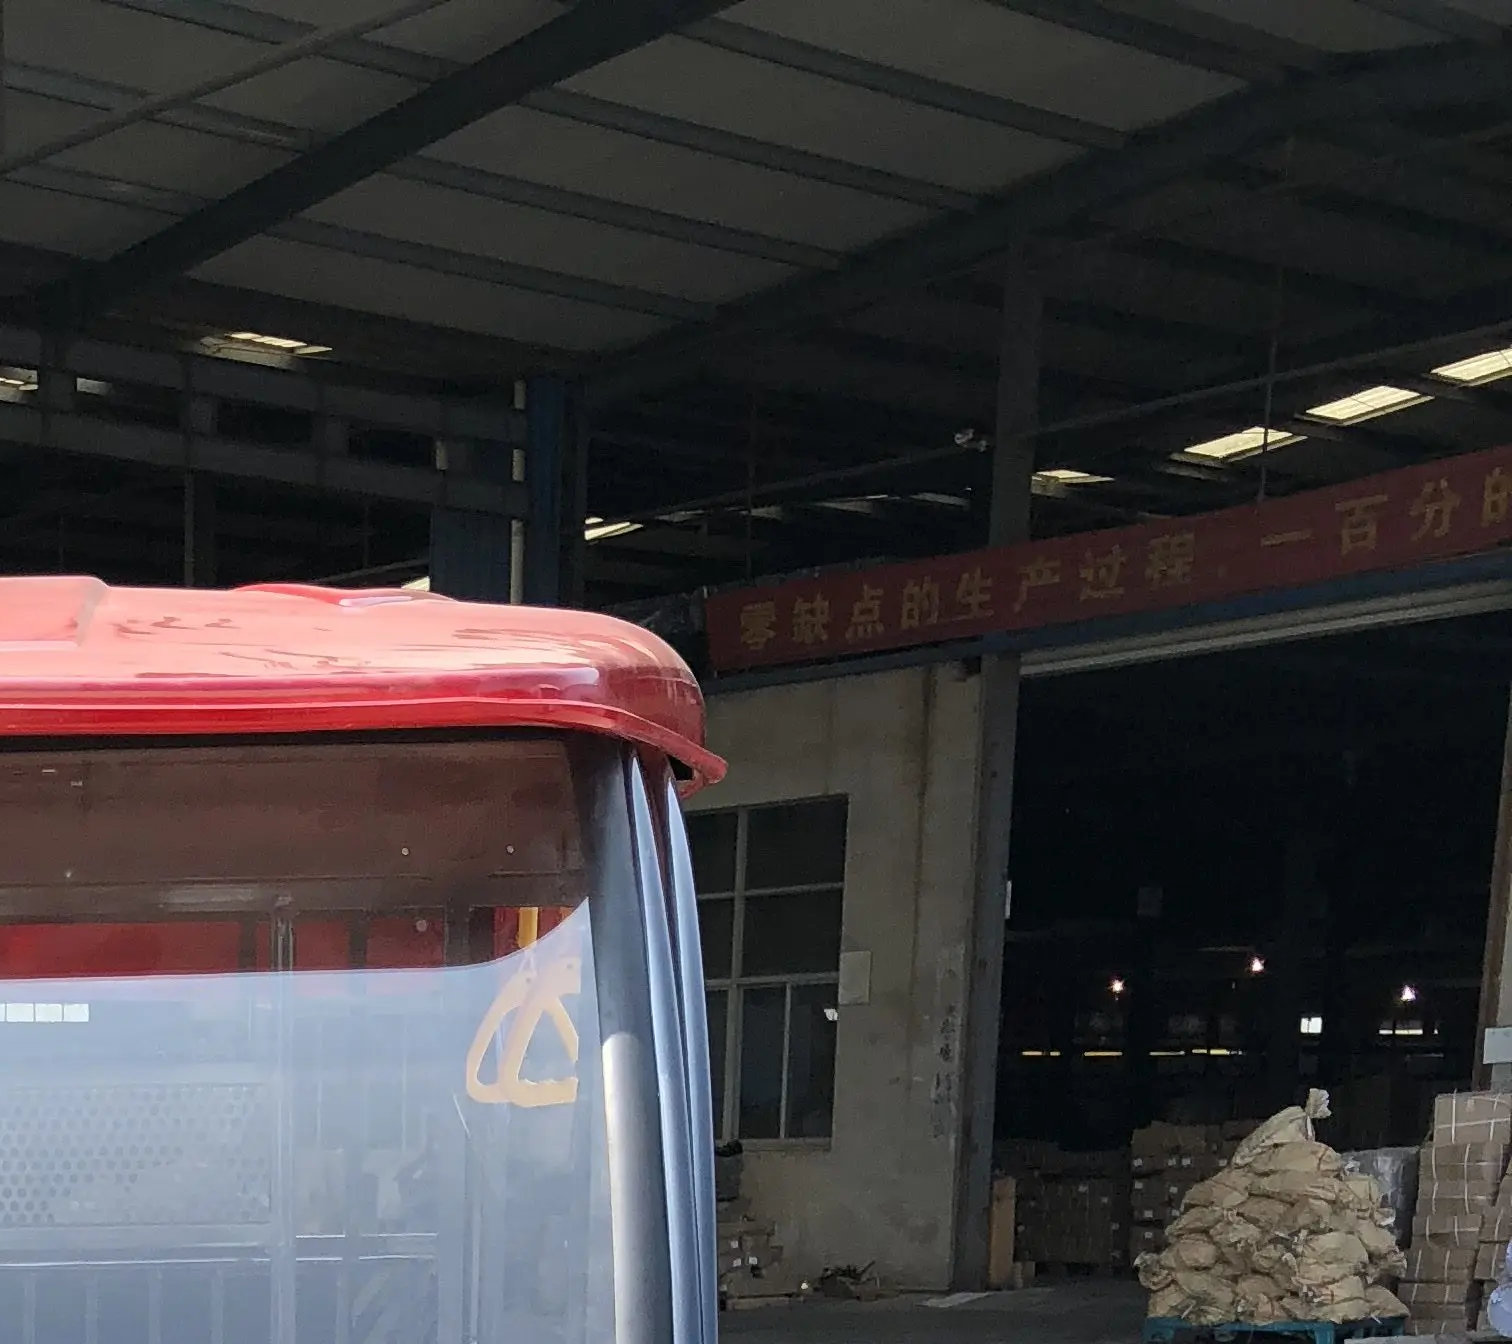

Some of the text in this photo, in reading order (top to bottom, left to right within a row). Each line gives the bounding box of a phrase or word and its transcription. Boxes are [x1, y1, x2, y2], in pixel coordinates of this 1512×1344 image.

[740, 531, 1195, 650] 零缺点的生产过程
